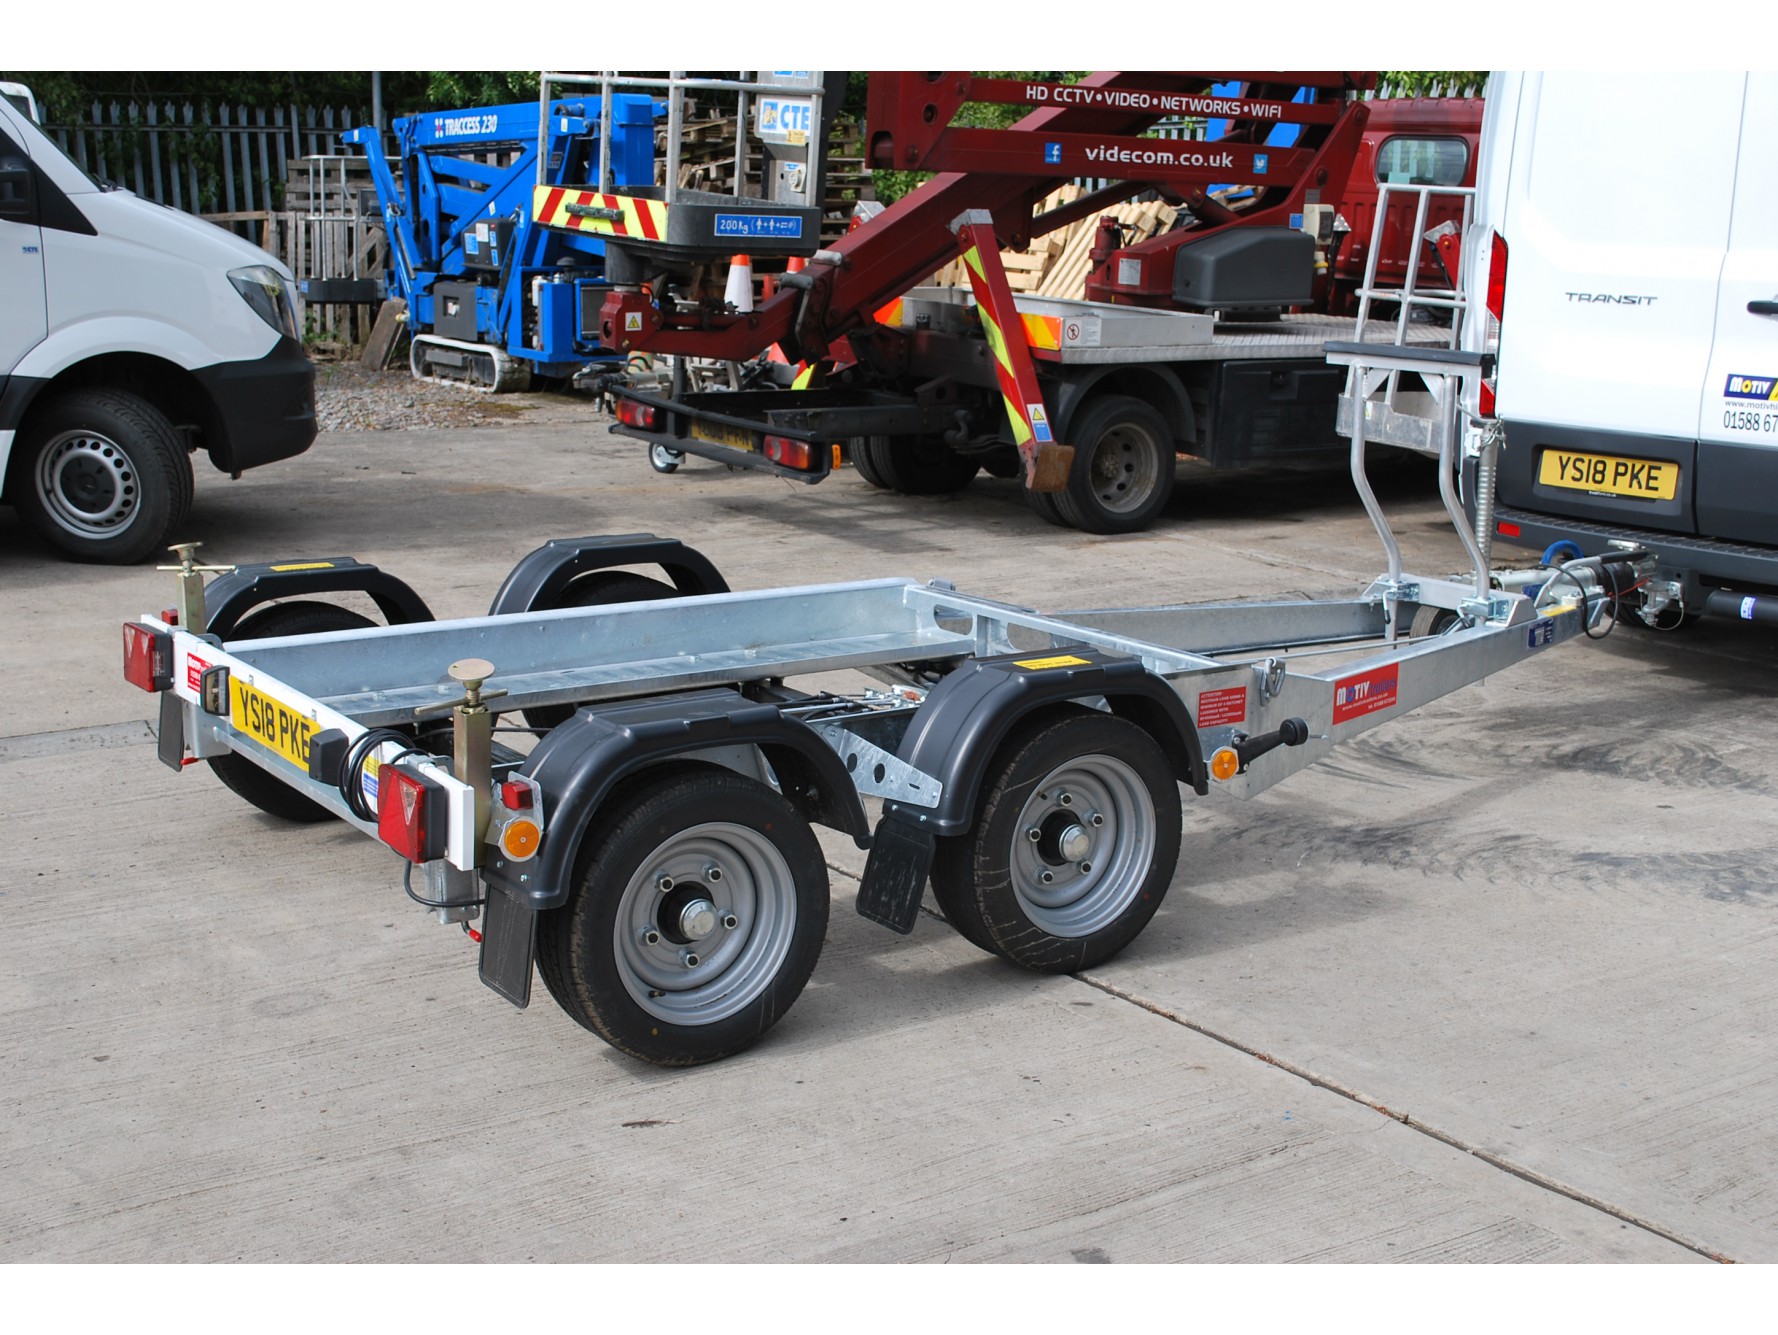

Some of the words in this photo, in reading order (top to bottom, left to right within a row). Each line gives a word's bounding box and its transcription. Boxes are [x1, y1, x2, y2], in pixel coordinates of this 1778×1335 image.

[1026, 86, 1048, 100] HD
[1053, 87, 1094, 104] CCTV
[1104, 91, 1150, 108] VIDEO
[1160, 95, 1241, 115] NETWORKS
[1250, 103, 1282, 119] WIFI
[444, 116, 481, 136] TRACCESS
[480, 114, 498, 134] 230
[780, 104, 811, 131] CTE
[1085, 145, 1234, 169] videcom.co.uk
[1565, 292, 1658, 306] TRANSIT
[1723, 410, 1761, 432] 01588
[1558, 455, 1607, 485] YS18
[1612, 461, 1663, 492] PKE
[239, 686, 275, 743] YS18
[278, 708, 311, 764] PKE
